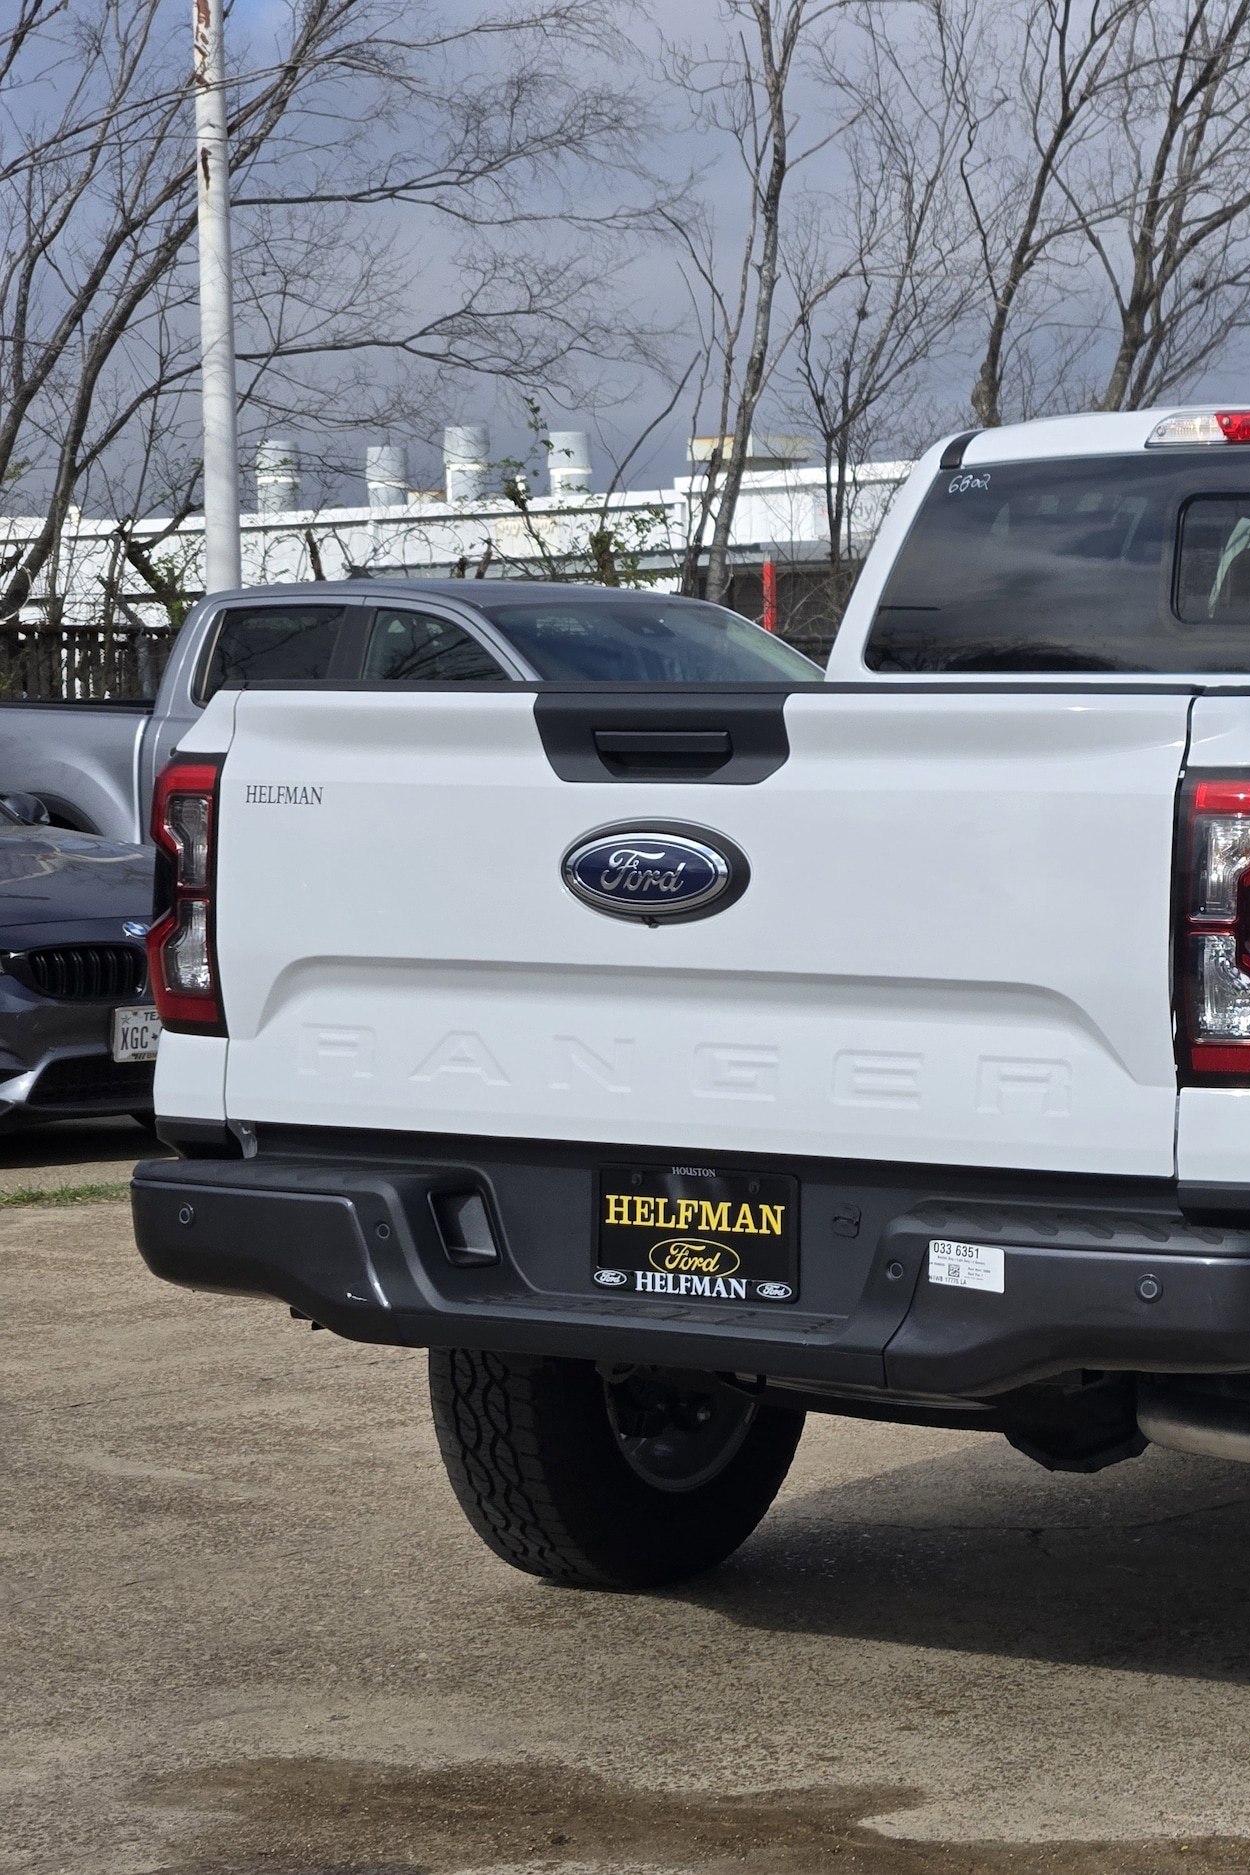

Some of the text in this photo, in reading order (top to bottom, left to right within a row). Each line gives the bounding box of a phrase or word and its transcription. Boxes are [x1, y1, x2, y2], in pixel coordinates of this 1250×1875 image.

[245, 784, 324, 805] HELFMAN
[600, 849, 687, 892] Ford
[120, 1026, 149, 1050] XGC
[296, 1022, 1074, 1118] RANGER
[671, 1166, 717, 1178] HOUSTON
[605, 1194, 786, 1235] HELFMAN
[664, 1242, 722, 1272] Ford
[933, 1242, 980, 1259] 033 6351
[599, 1271, 787, 1299] Ford HELFMAN Ford
